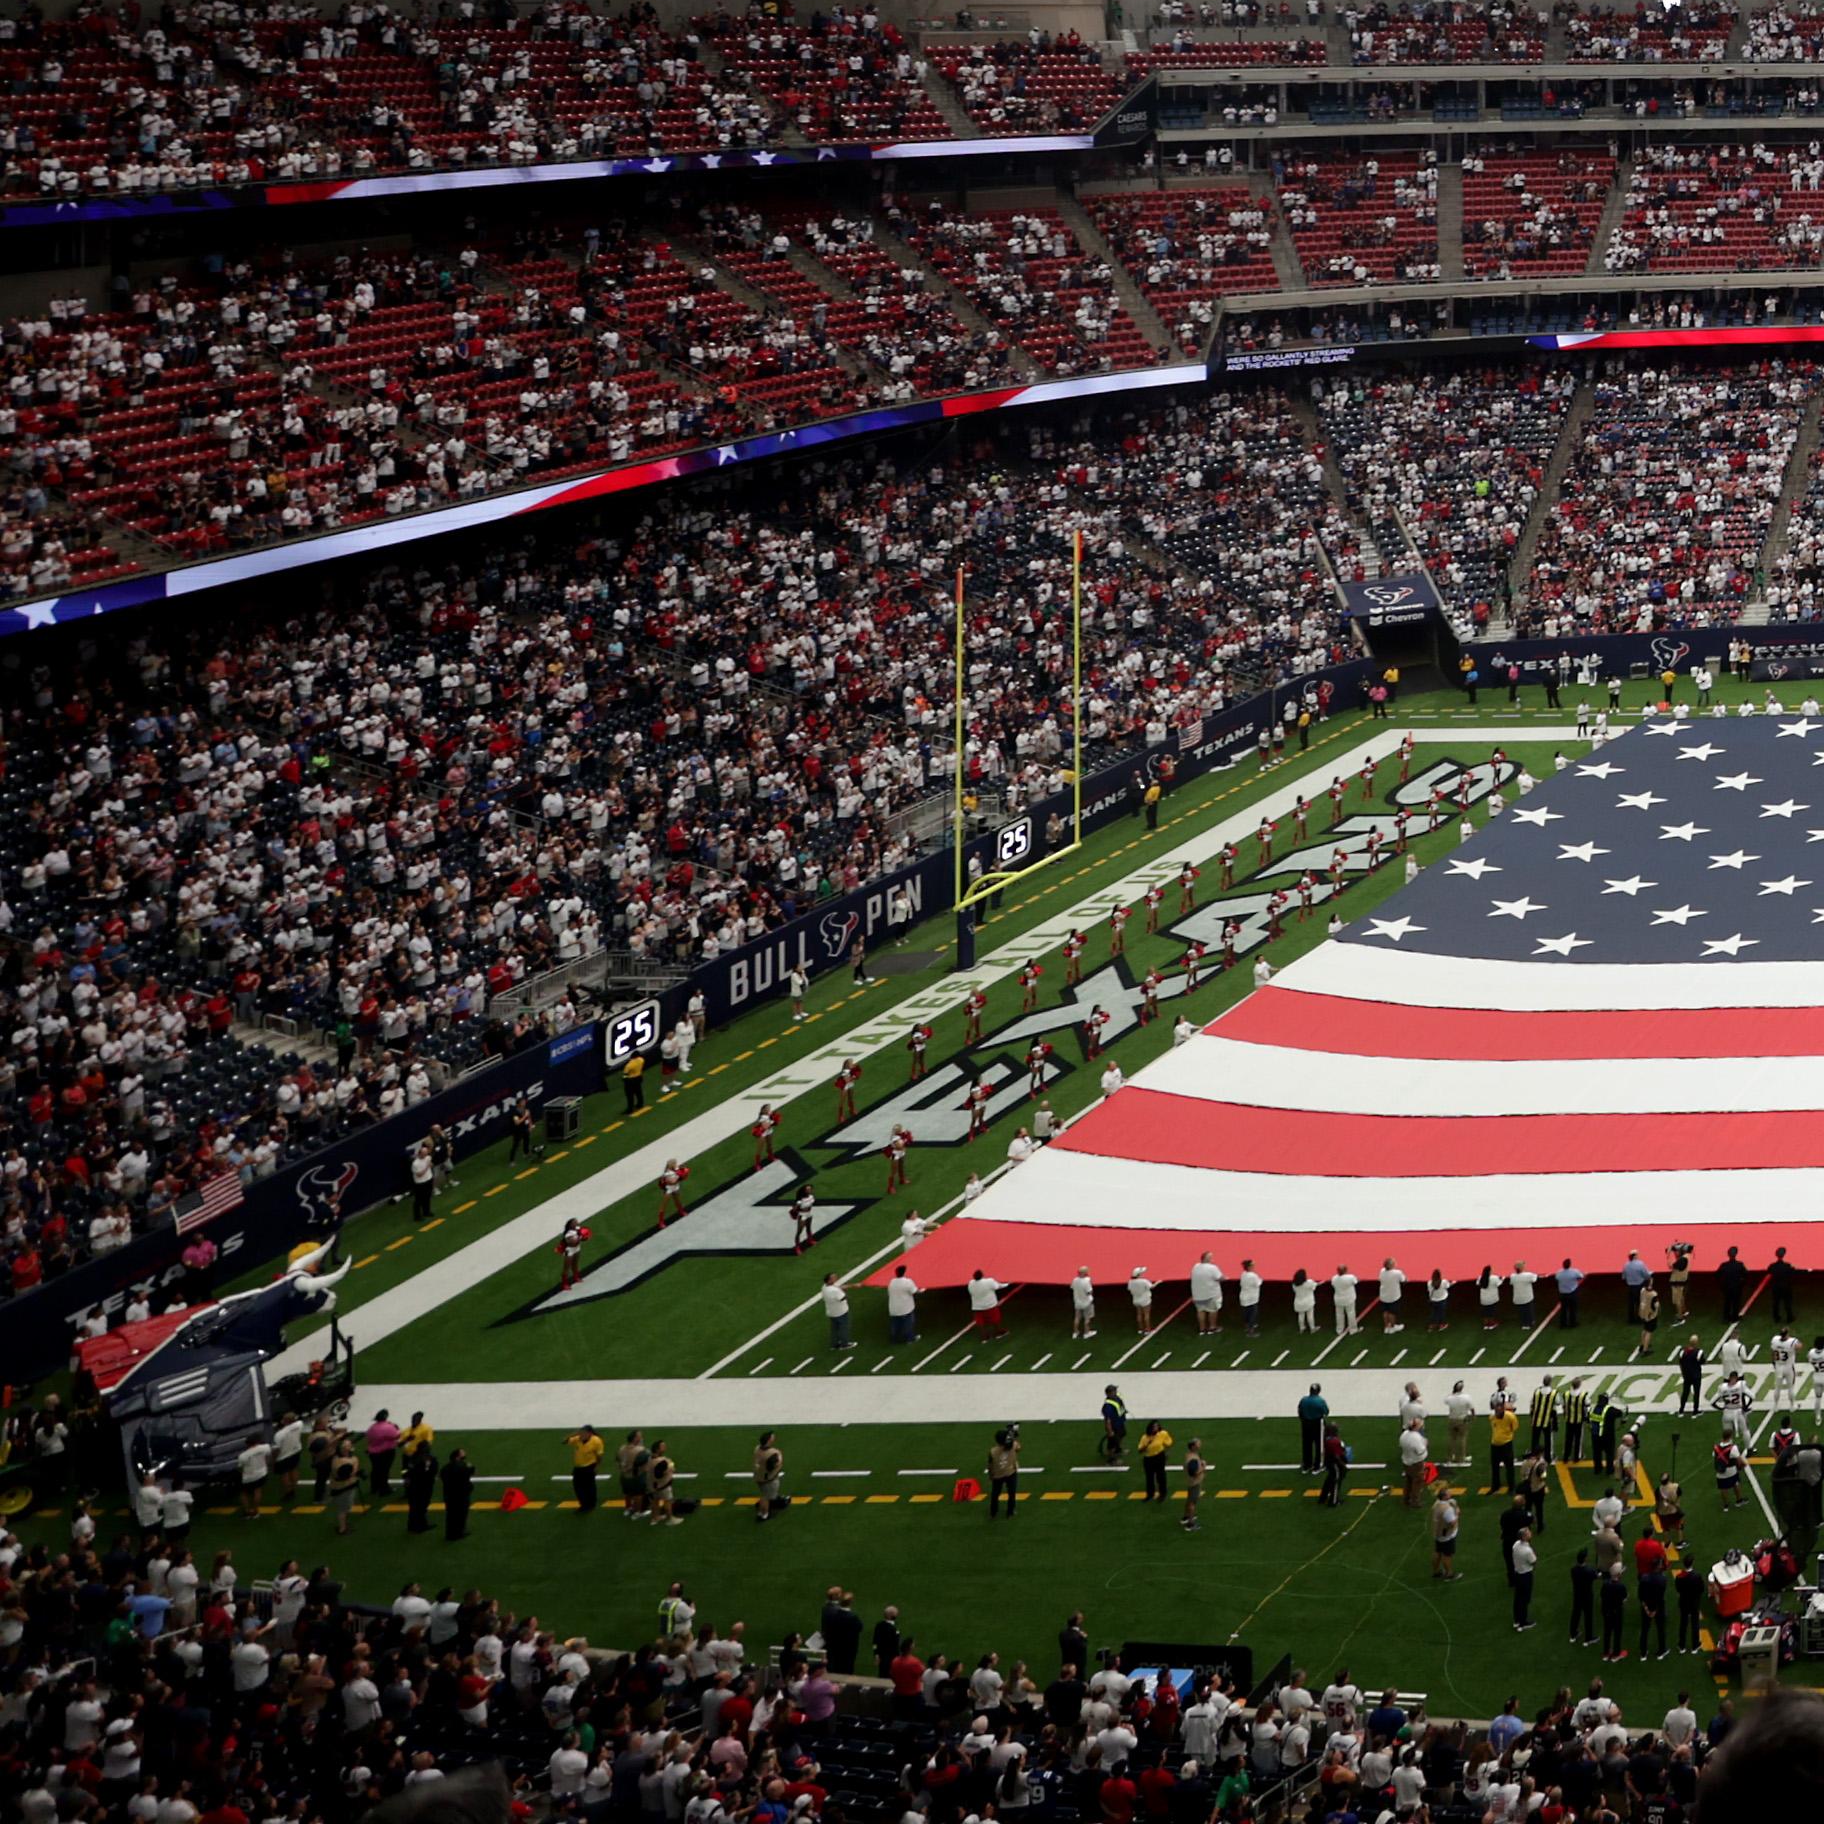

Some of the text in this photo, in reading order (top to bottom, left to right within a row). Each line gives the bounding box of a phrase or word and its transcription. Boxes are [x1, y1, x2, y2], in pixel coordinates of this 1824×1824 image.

[1117, 111, 1147, 123] CAESARS
[1385, 612, 1424, 623] Chevron
[1193, 722, 1254, 760] TEXANS
[1060, 788, 1127, 826] TEXANS
[1002, 825, 1026, 860] 25
[729, 874, 922, 1006] BULL PEN
[741, 860, 1188, 1101] IT TAKES ALL OF US
[525, 758, 1523, 1314] TEXANS
[614, 1010, 651, 1056] 25
[65, 1230, 245, 1329] TEXAS
[1327, 1702, 1345, 1717] 56
